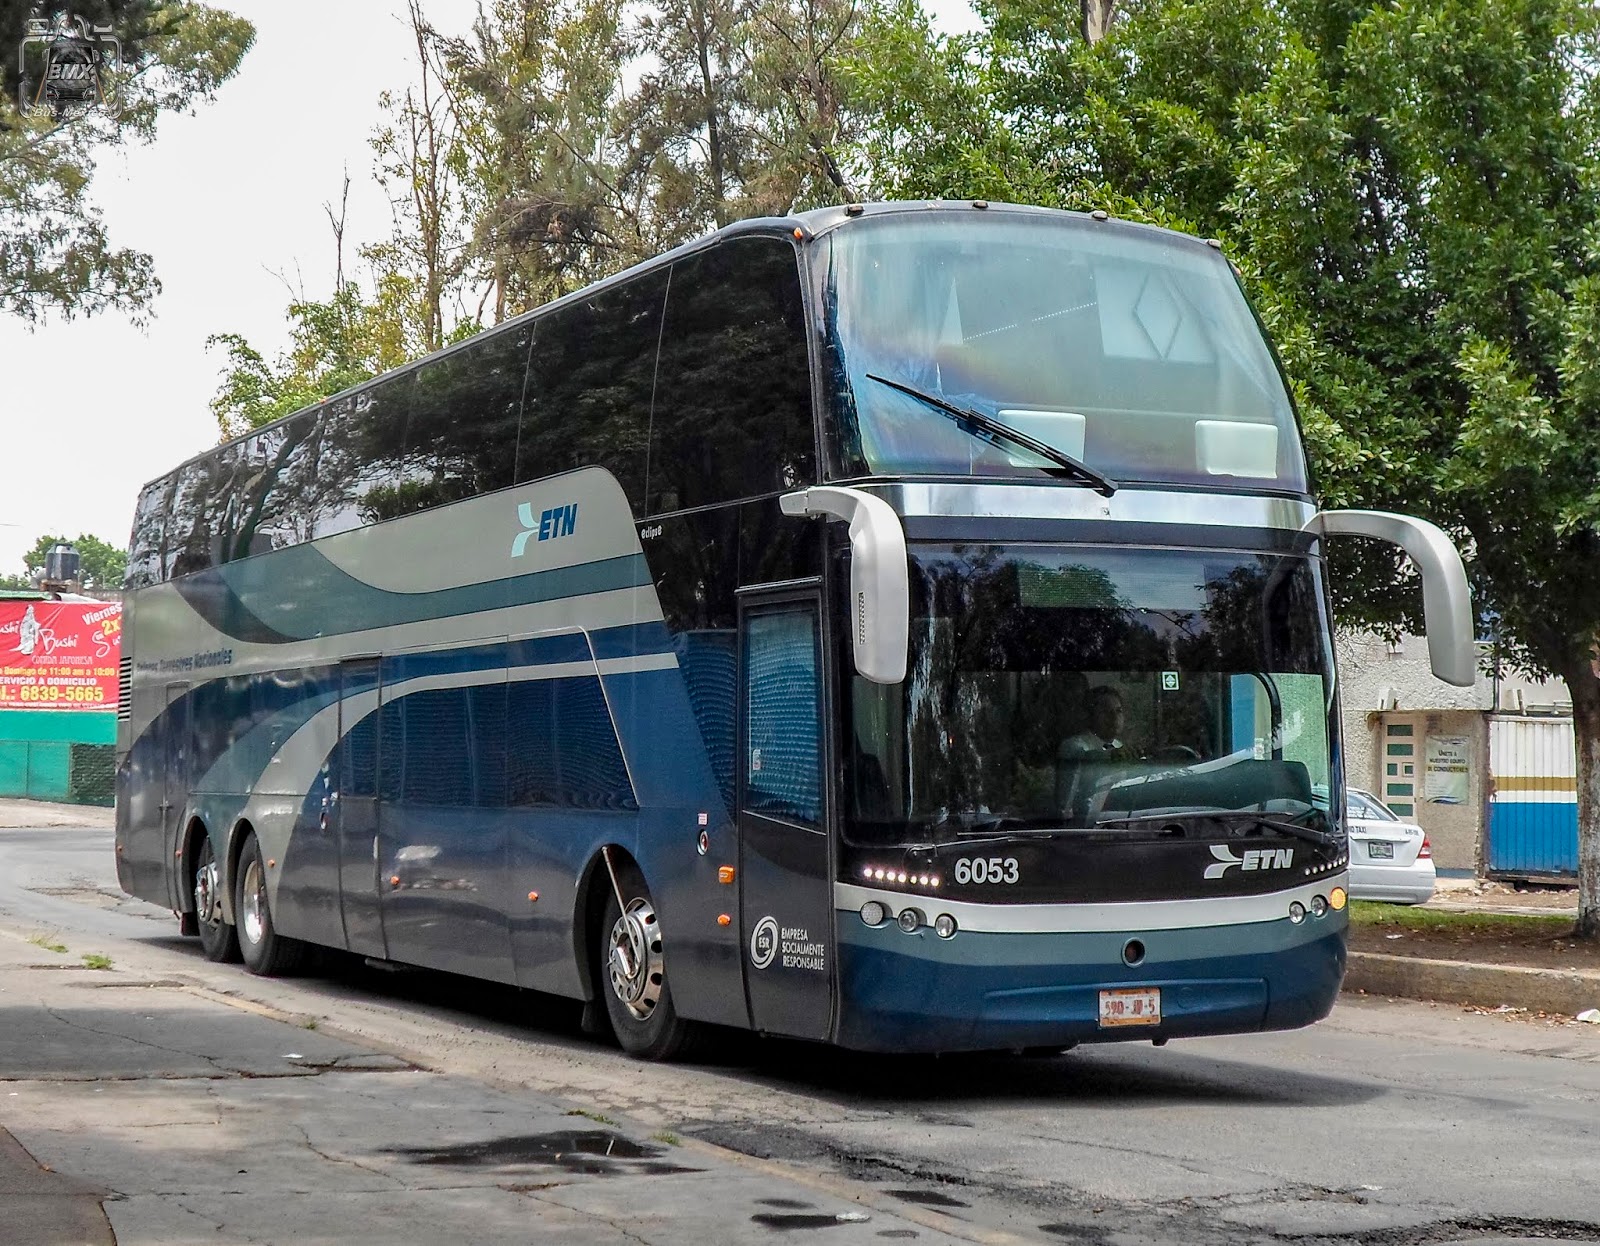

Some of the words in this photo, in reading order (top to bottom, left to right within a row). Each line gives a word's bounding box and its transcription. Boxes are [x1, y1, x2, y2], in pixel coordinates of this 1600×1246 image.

[538, 503, 578, 541] ETN
[641, 524, 662, 539] eclipse
[81, 602, 122, 625] Viernes
[101, 614, 121, 636] 2x
[39, 628, 78, 655] Bushi
[47, 678, 97, 686] DOMICILIO
[20, 686, 104, 701] 6839-5665
[1241, 849, 1294, 871] ETN
[954, 857, 1020, 885] 6053
[781, 927, 809, 942] EMPRESA
[758, 936, 770, 950] ESR
[781, 941, 824, 957] SOCIALMENTE
[782, 955, 824, 971] RESPONSABLE
